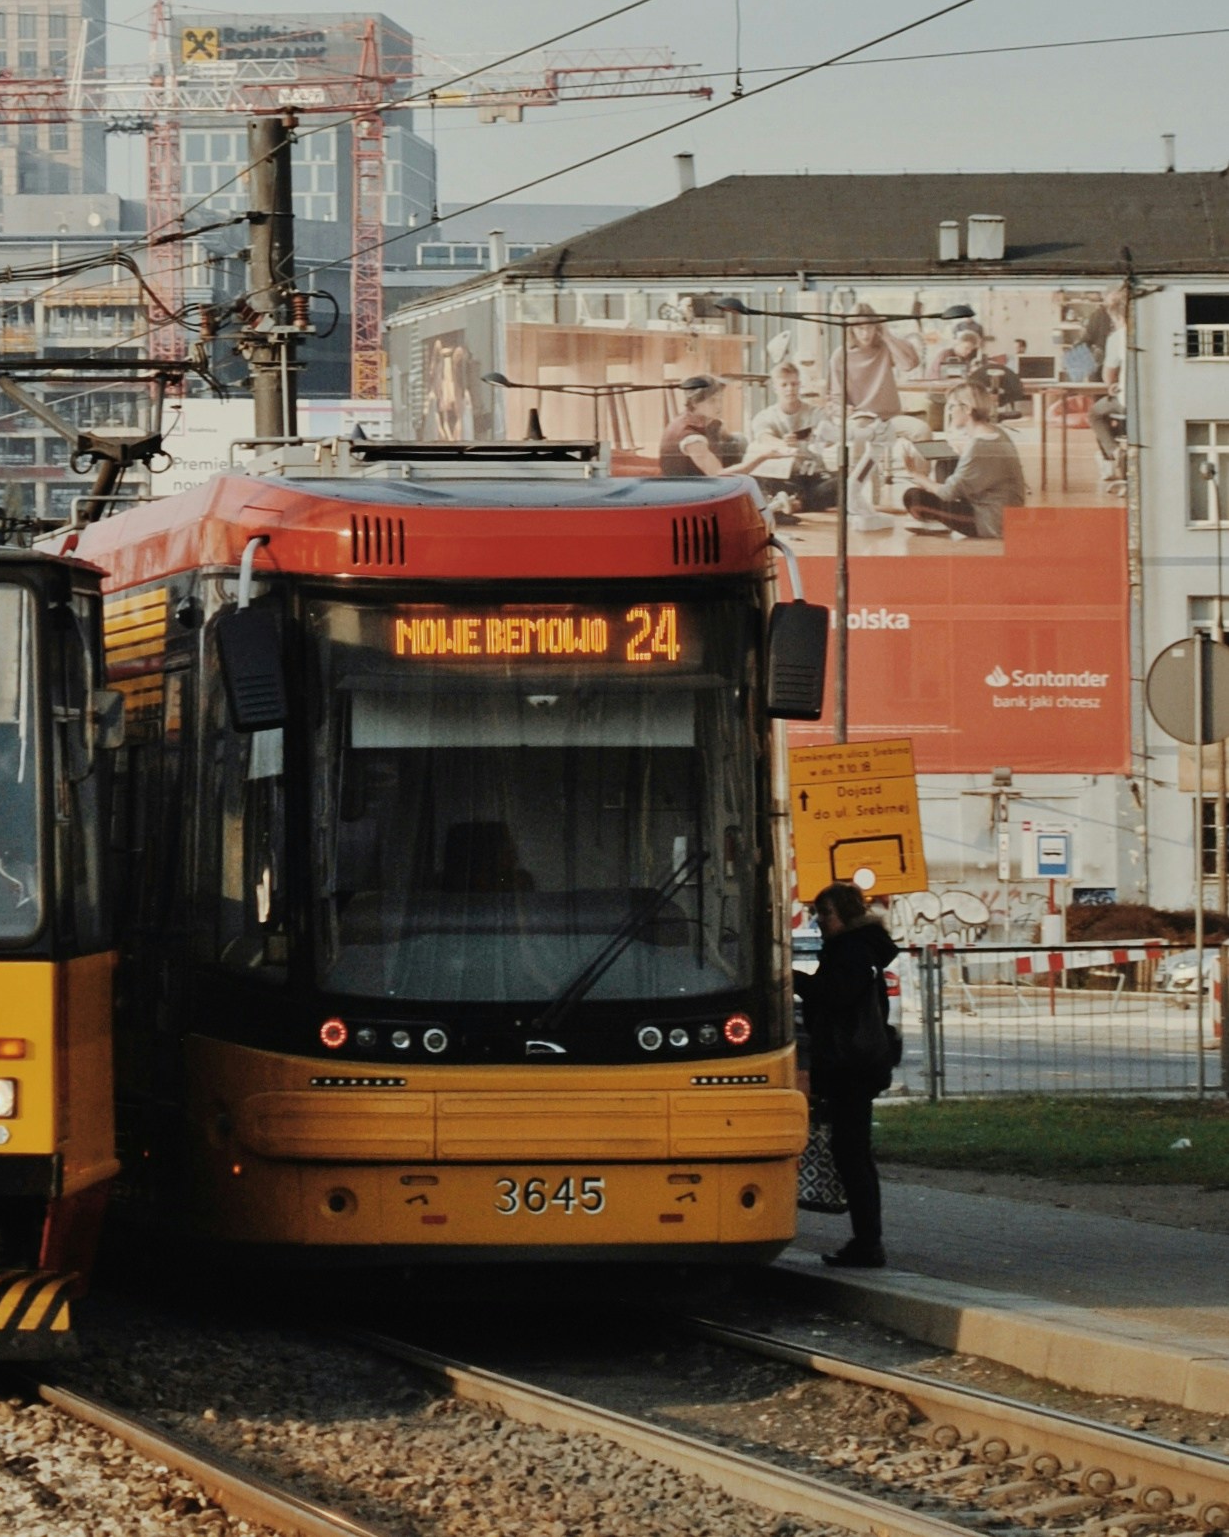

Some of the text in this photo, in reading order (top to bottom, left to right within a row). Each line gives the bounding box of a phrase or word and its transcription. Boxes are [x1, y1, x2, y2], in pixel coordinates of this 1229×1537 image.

[173, 456, 243, 471] Premiea
[396, 607, 682, 662] NOWE BEMOWO 24
[1011, 669, 1109, 688] Santander
[993, 695, 1100, 710] bank jaki chcesz
[836, 783, 882, 799] Dojazd
[813, 808, 830, 820] do
[856, 801, 910, 817] Srebrnej
[494, 1177, 607, 1216] 3645
